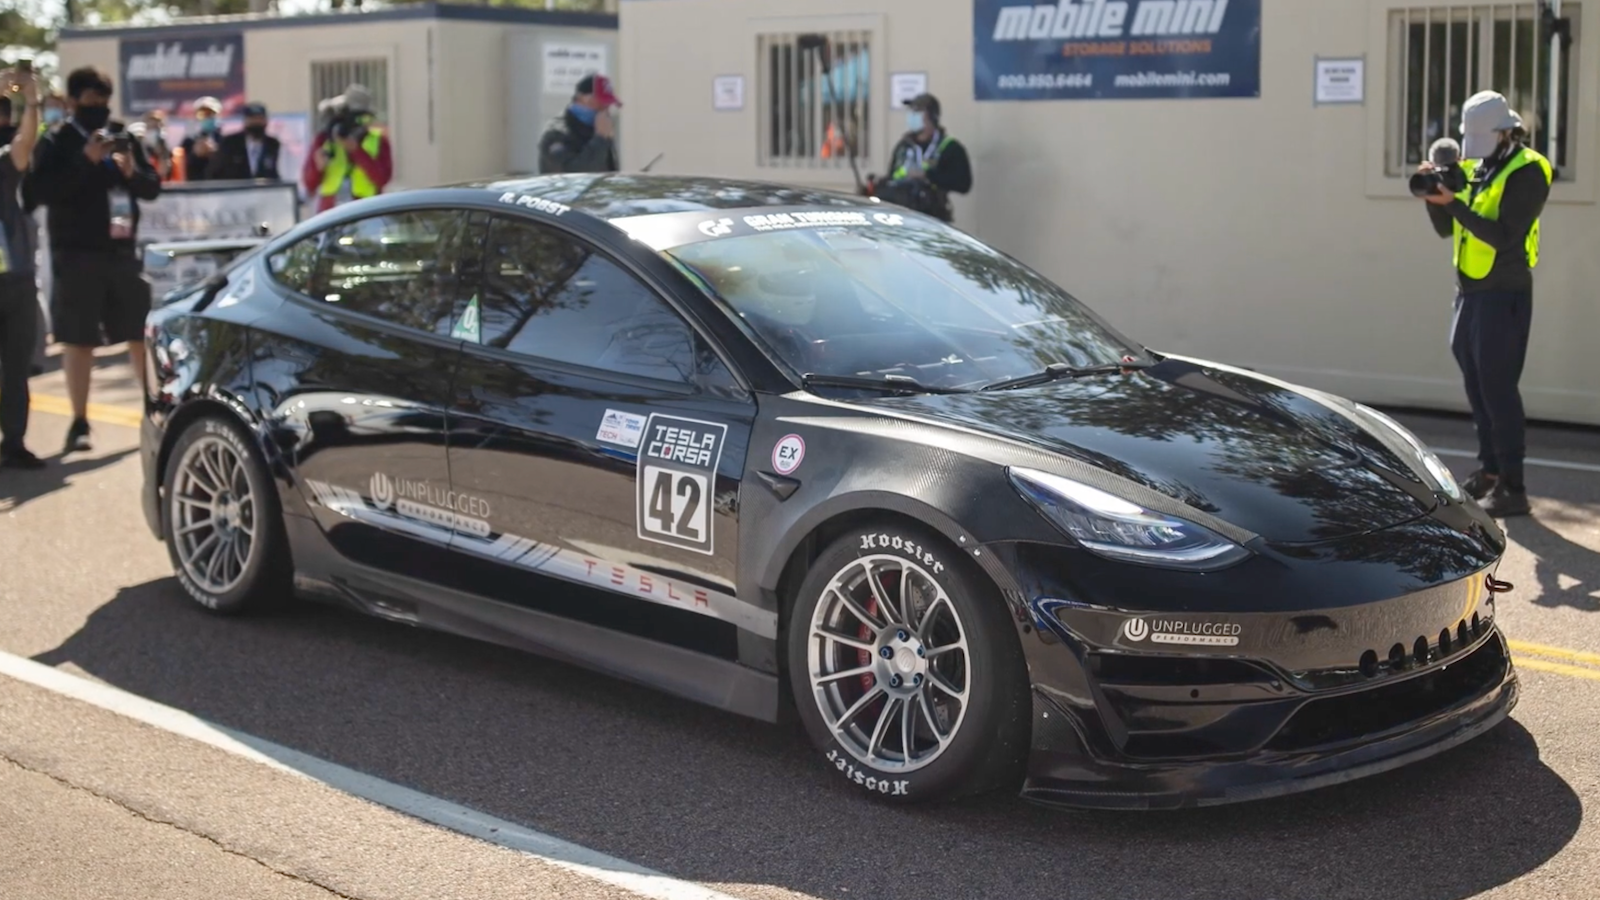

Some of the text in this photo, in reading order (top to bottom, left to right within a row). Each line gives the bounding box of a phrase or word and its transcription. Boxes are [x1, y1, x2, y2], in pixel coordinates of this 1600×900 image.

[992, 0, 1229, 40] mobile mini
[1129, 39, 1213, 54] SOLUTIONS
[1114, 71, 1231, 88] mobilemini.com
[516, 195, 571, 216] POBST
[743, 212, 796, 228] GRAN
[600, 430, 618, 440] TECH
[655, 425, 716, 450] TESLA
[647, 441, 711, 467] CORSA
[779, 445, 798, 460] EX
[395, 477, 491, 518] UNPLUGGED
[649, 471, 701, 540] 42
[401, 503, 486, 533] PERFORMANCE
[860, 532, 944, 575] Hoosier
[583, 559, 709, 608] TESLA
[1152, 619, 1242, 636] UNPLUGGED
[1156, 635, 1235, 643] PERFORMANCE
[826, 749, 910, 796] Hoosier
